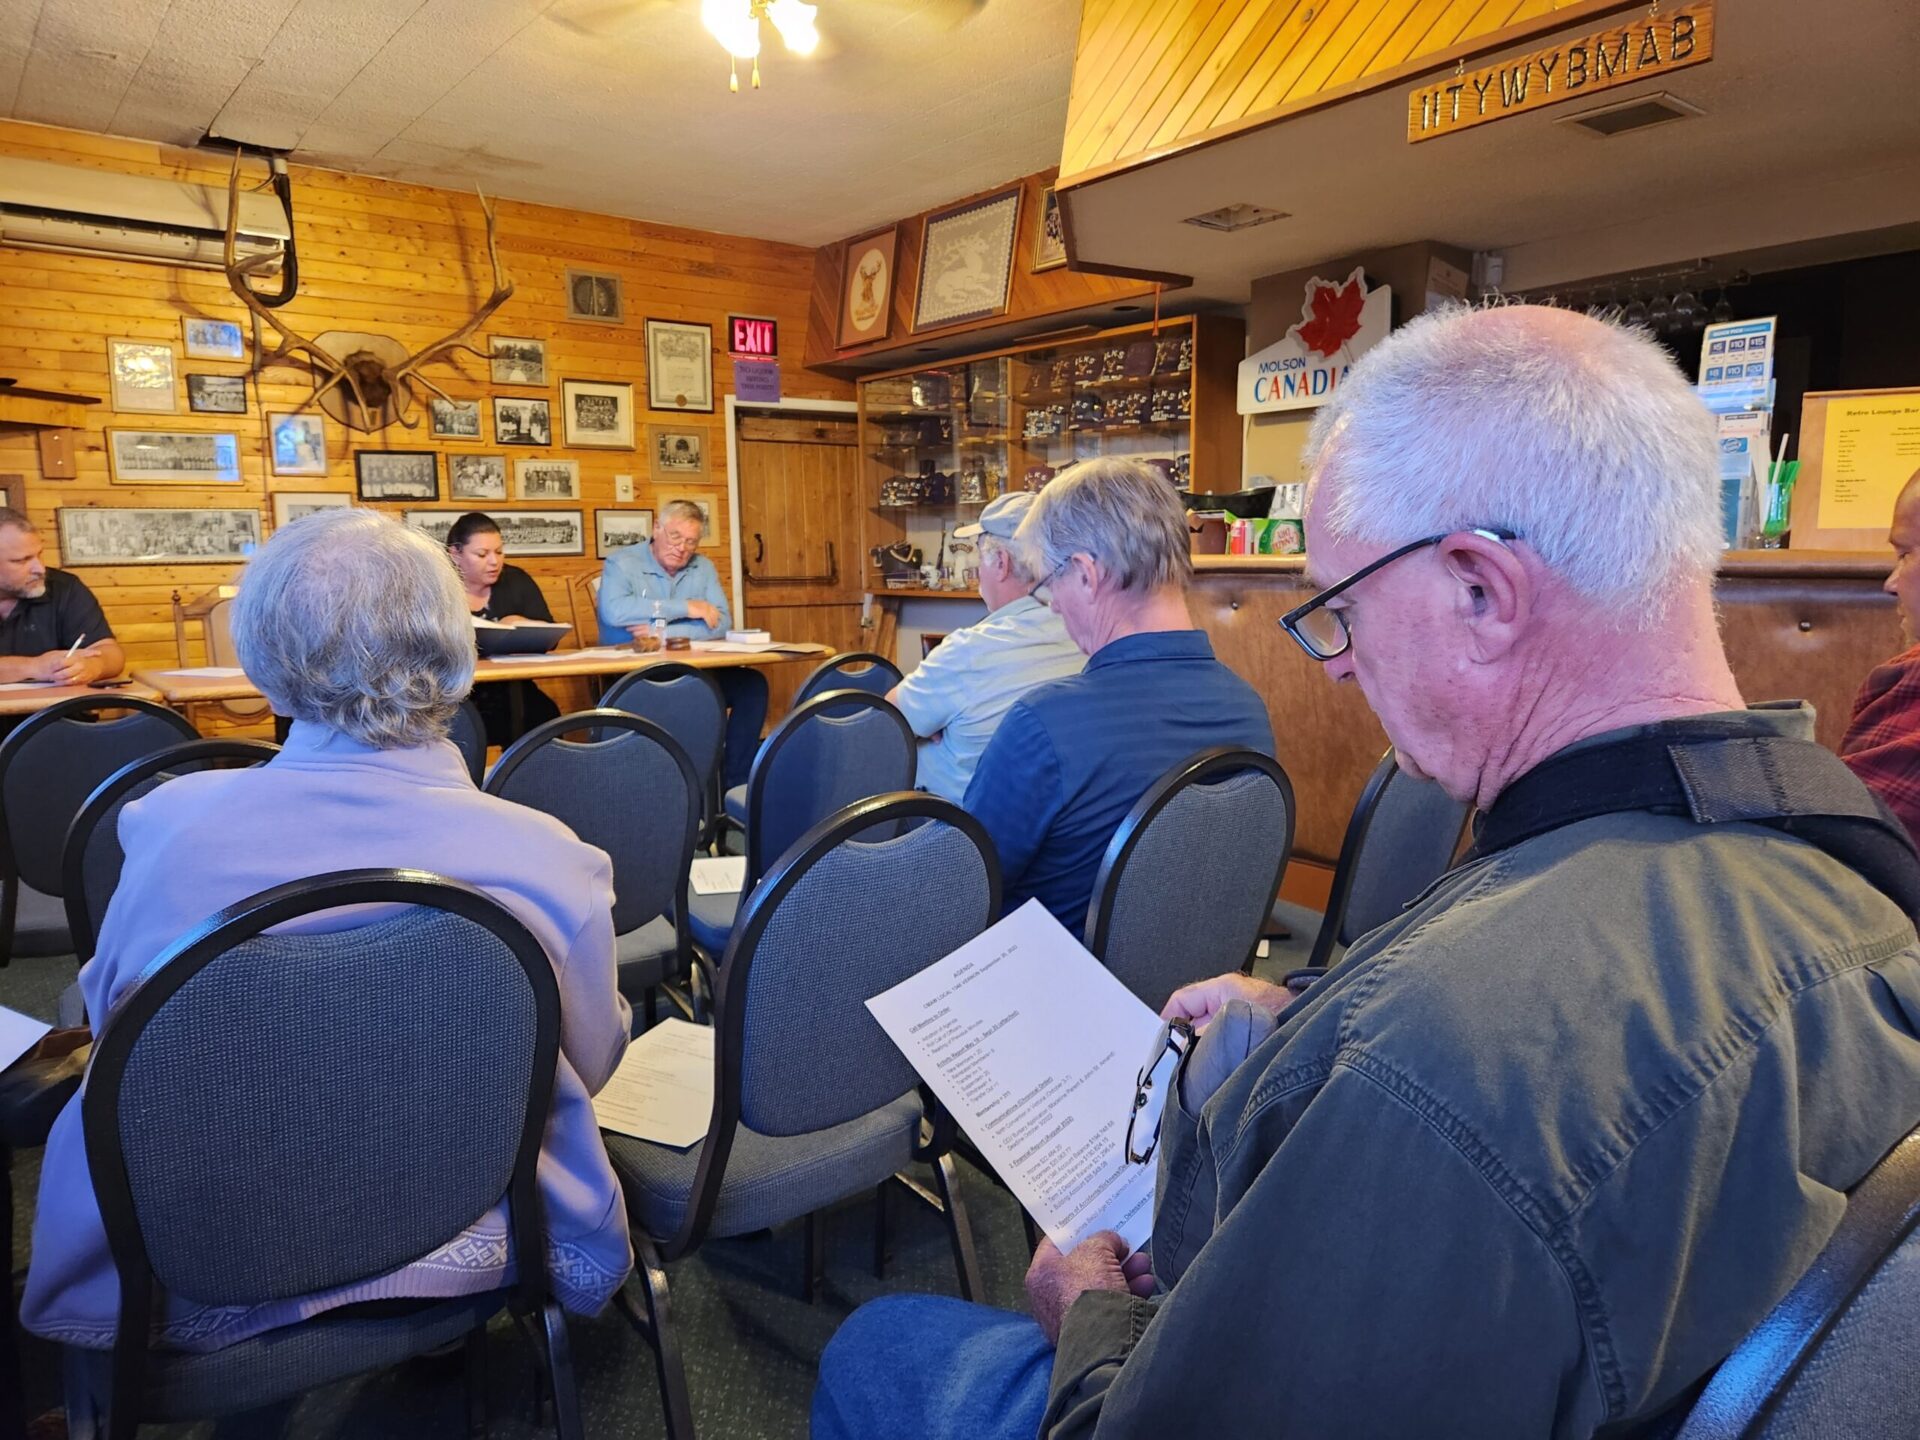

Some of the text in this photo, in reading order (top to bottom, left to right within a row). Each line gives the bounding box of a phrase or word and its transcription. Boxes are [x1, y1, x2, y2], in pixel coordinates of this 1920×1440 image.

[1422, 15, 1697, 130] IITYWYBMAB
[734, 319, 773, 354] EXIT
[1258, 357, 1306, 374] MOLSON
[1254, 365, 1349, 403] CANADI
[1872, 408, 1902, 416] Lounge
[937, 989, 952, 1000] LOCAL
[980, 957, 1001, 973] September
[953, 962, 974, 978] AGENDA
[909, 1026, 918, 1034] Call
[917, 1017, 934, 1029] Meeting
[938, 1006, 951, 1016] Order
[943, 1018, 958, 1029] Agenda
[946, 1024, 962, 1036] Officers
[931, 1042, 948, 1054] Reading
[951, 1029, 968, 1041] Previous
[967, 1019, 984, 1031] Minutes
[951, 1047, 966, 1059] Report
[965, 1041, 975, 1050] May
[947, 1066, 956, 1074] New
[956, 1055, 974, 1068] Members
[956, 1073, 972, 1085] Transfer
[970, 1091, 987, 1103] Transfer
[985, 1085, 994, 1093] Out
[985, 1104, 1018, 1130] Communications
[1038, 1076, 1054, 1090] Order)
[976, 1099, 1001, 1118] Membership
[1006, 1111, 1027, 1129] Convention
[1031, 1096, 1046, 1108] Victoria
[1012, 1125, 1028, 1138] Bursary
[1027, 1109, 1048, 1127] Application
[1025, 1126, 1039, 1138] October
[1012, 1151, 1031, 1166] Financial
[1030, 1139, 1046, 1153] Report
[1044, 1126, 1063, 1142] (August
[1027, 1163, 1041, 1175] Income
[1032, 1166, 1051, 1182] Expenses
[1037, 1179, 1049, 1189] Local
[1057, 1157, 1074, 1172] Account
[1073, 1143, 1090, 1159] Balance
[1053, 1173, 1069, 1188] Deposit
[1067, 1160, 1085, 1174] Balance
[1061, 1177, 1078, 1191] Deposit
[1076, 1163, 1094, 1178] Balance
[1053, 1195, 1071, 1210] Building
[1069, 1181, 1086, 1196] Account
[1123, 1197, 1148, 1220] Delegates
